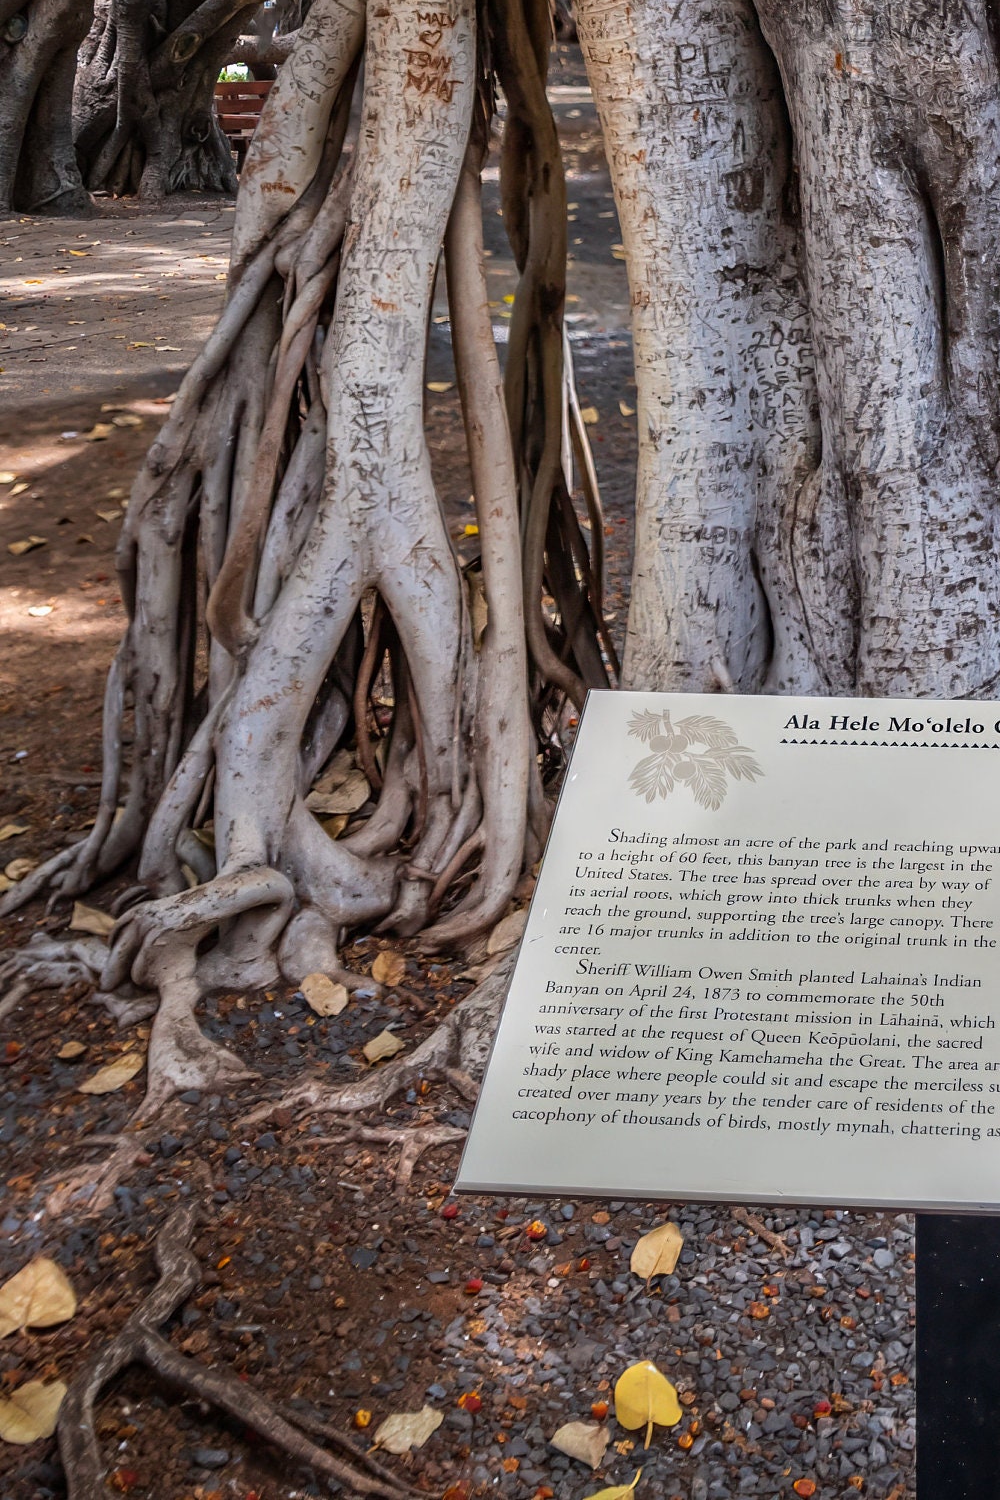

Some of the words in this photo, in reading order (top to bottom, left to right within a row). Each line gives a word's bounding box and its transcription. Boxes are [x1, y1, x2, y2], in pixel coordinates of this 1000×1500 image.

[782, 714, 821, 730] Ala
[828, 715, 880, 731] Hele
[607, 827, 668, 849] Shading
[672, 832, 720, 846] almost
[723, 838, 741, 847] an
[745, 839, 774, 848] acre
[778, 836, 797, 849] of
[798, 836, 821, 850] the
[824, 838, 857, 854] park
[861, 839, 889, 851] and
[893, 839, 954, 857] reaching
[578, 851, 593, 861] to
[597, 852, 605, 861] a
[610, 848, 655, 866] height
[659, 850, 678, 863] of
[678, 851, 698, 864] 60
[702, 851, 732, 866] feet,
[737, 852, 763, 866] this
[768, 853, 819, 870] banyan
[825, 859, 852, 869] tree
[856, 857, 867, 869] is
[872, 856, 895, 870] the
[899, 857, 945, 875] largest
[950, 859, 964, 872] in
[970, 859, 993, 872] the
[575, 866, 624, 880] United
[627, 868, 673, 881] States.
[678, 869, 707, 883] The
[712, 874, 739, 884] tree
[743, 871, 766, 885] has
[770, 873, 817, 889] spread
[821, 878, 853, 887] over
[857, 875, 881, 888] the
[884, 880, 913, 889] area
[919, 876, 937, 893] by
[941, 881, 970, 894] way
[974, 878, 993, 891] of
[554, 945, 601, 956] center.
[575, 958, 632, 976] Sheriff
[634, 963, 692, 979] William
[698, 966, 743, 981] Owen
[748, 968, 793, 988] Smith
[798, 969, 855, 987] planted
[933, 973, 982, 988] Indian
[544, 980, 599, 998] Banyan
[604, 987, 624, 996] on
[628, 983, 668, 1001] April
[672, 985, 696, 1000] 24,
[704, 987, 740, 1001] 1873
[746, 992, 761, 1001] to
[766, 991, 876, 1005] commemorate
[881, 991, 905, 1006] the
[910, 993, 945, 1007] 50th
[538, 1001, 625, 1021] anniversary
[628, 1003, 649, 1017] of
[649, 1004, 674, 1019] the
[678, 1005, 708, 1020] first
[713, 1007, 790, 1023] Protestant
[794, 1010, 852, 1025] mission
[858, 1012, 873, 1025] in
[879, 1012, 944, 1029] Lāhainā,
[950, 1014, 995, 1028] which
[529, 1041, 561, 1056] wife
[564, 1043, 594, 1057] and
[599, 1044, 650, 1059] widow
[654, 1046, 675, 1060] of
[675, 1047, 714, 1066] King
[719, 1049, 823, 1066] Kamehameha
[829, 1052, 854, 1067] the
[859, 1054, 906, 1069] Great.
[911, 1055, 944, 1070] The
[948, 1061, 979, 1071] area
[517, 1085, 573, 1100] created
[577, 1091, 611, 1101] over
[615, 1092, 660, 1107] many
[662, 1094, 702, 1108] years
[707, 1090, 727, 1110] by
[732, 1091, 757, 1107] the
[762, 1094, 812, 1109] tender
[816, 1100, 848, 1110] care
[853, 1096, 873, 1111] of
[875, 1097, 943, 1113] residents
[948, 1099, 968, 1114] of
[971, 1099, 995, 1115] the
[512, 1106, 597, 1127] cacophony
[600, 1108, 622, 1124] of
[622, 1109, 701, 1127] thousands
[706, 1113, 727, 1128] of
[728, 1113, 771, 1131] birds,
[777, 1116, 831, 1136] mostly
[836, 1119, 895, 1137] mynah,
[900, 1120, 981, 1142] chattering
